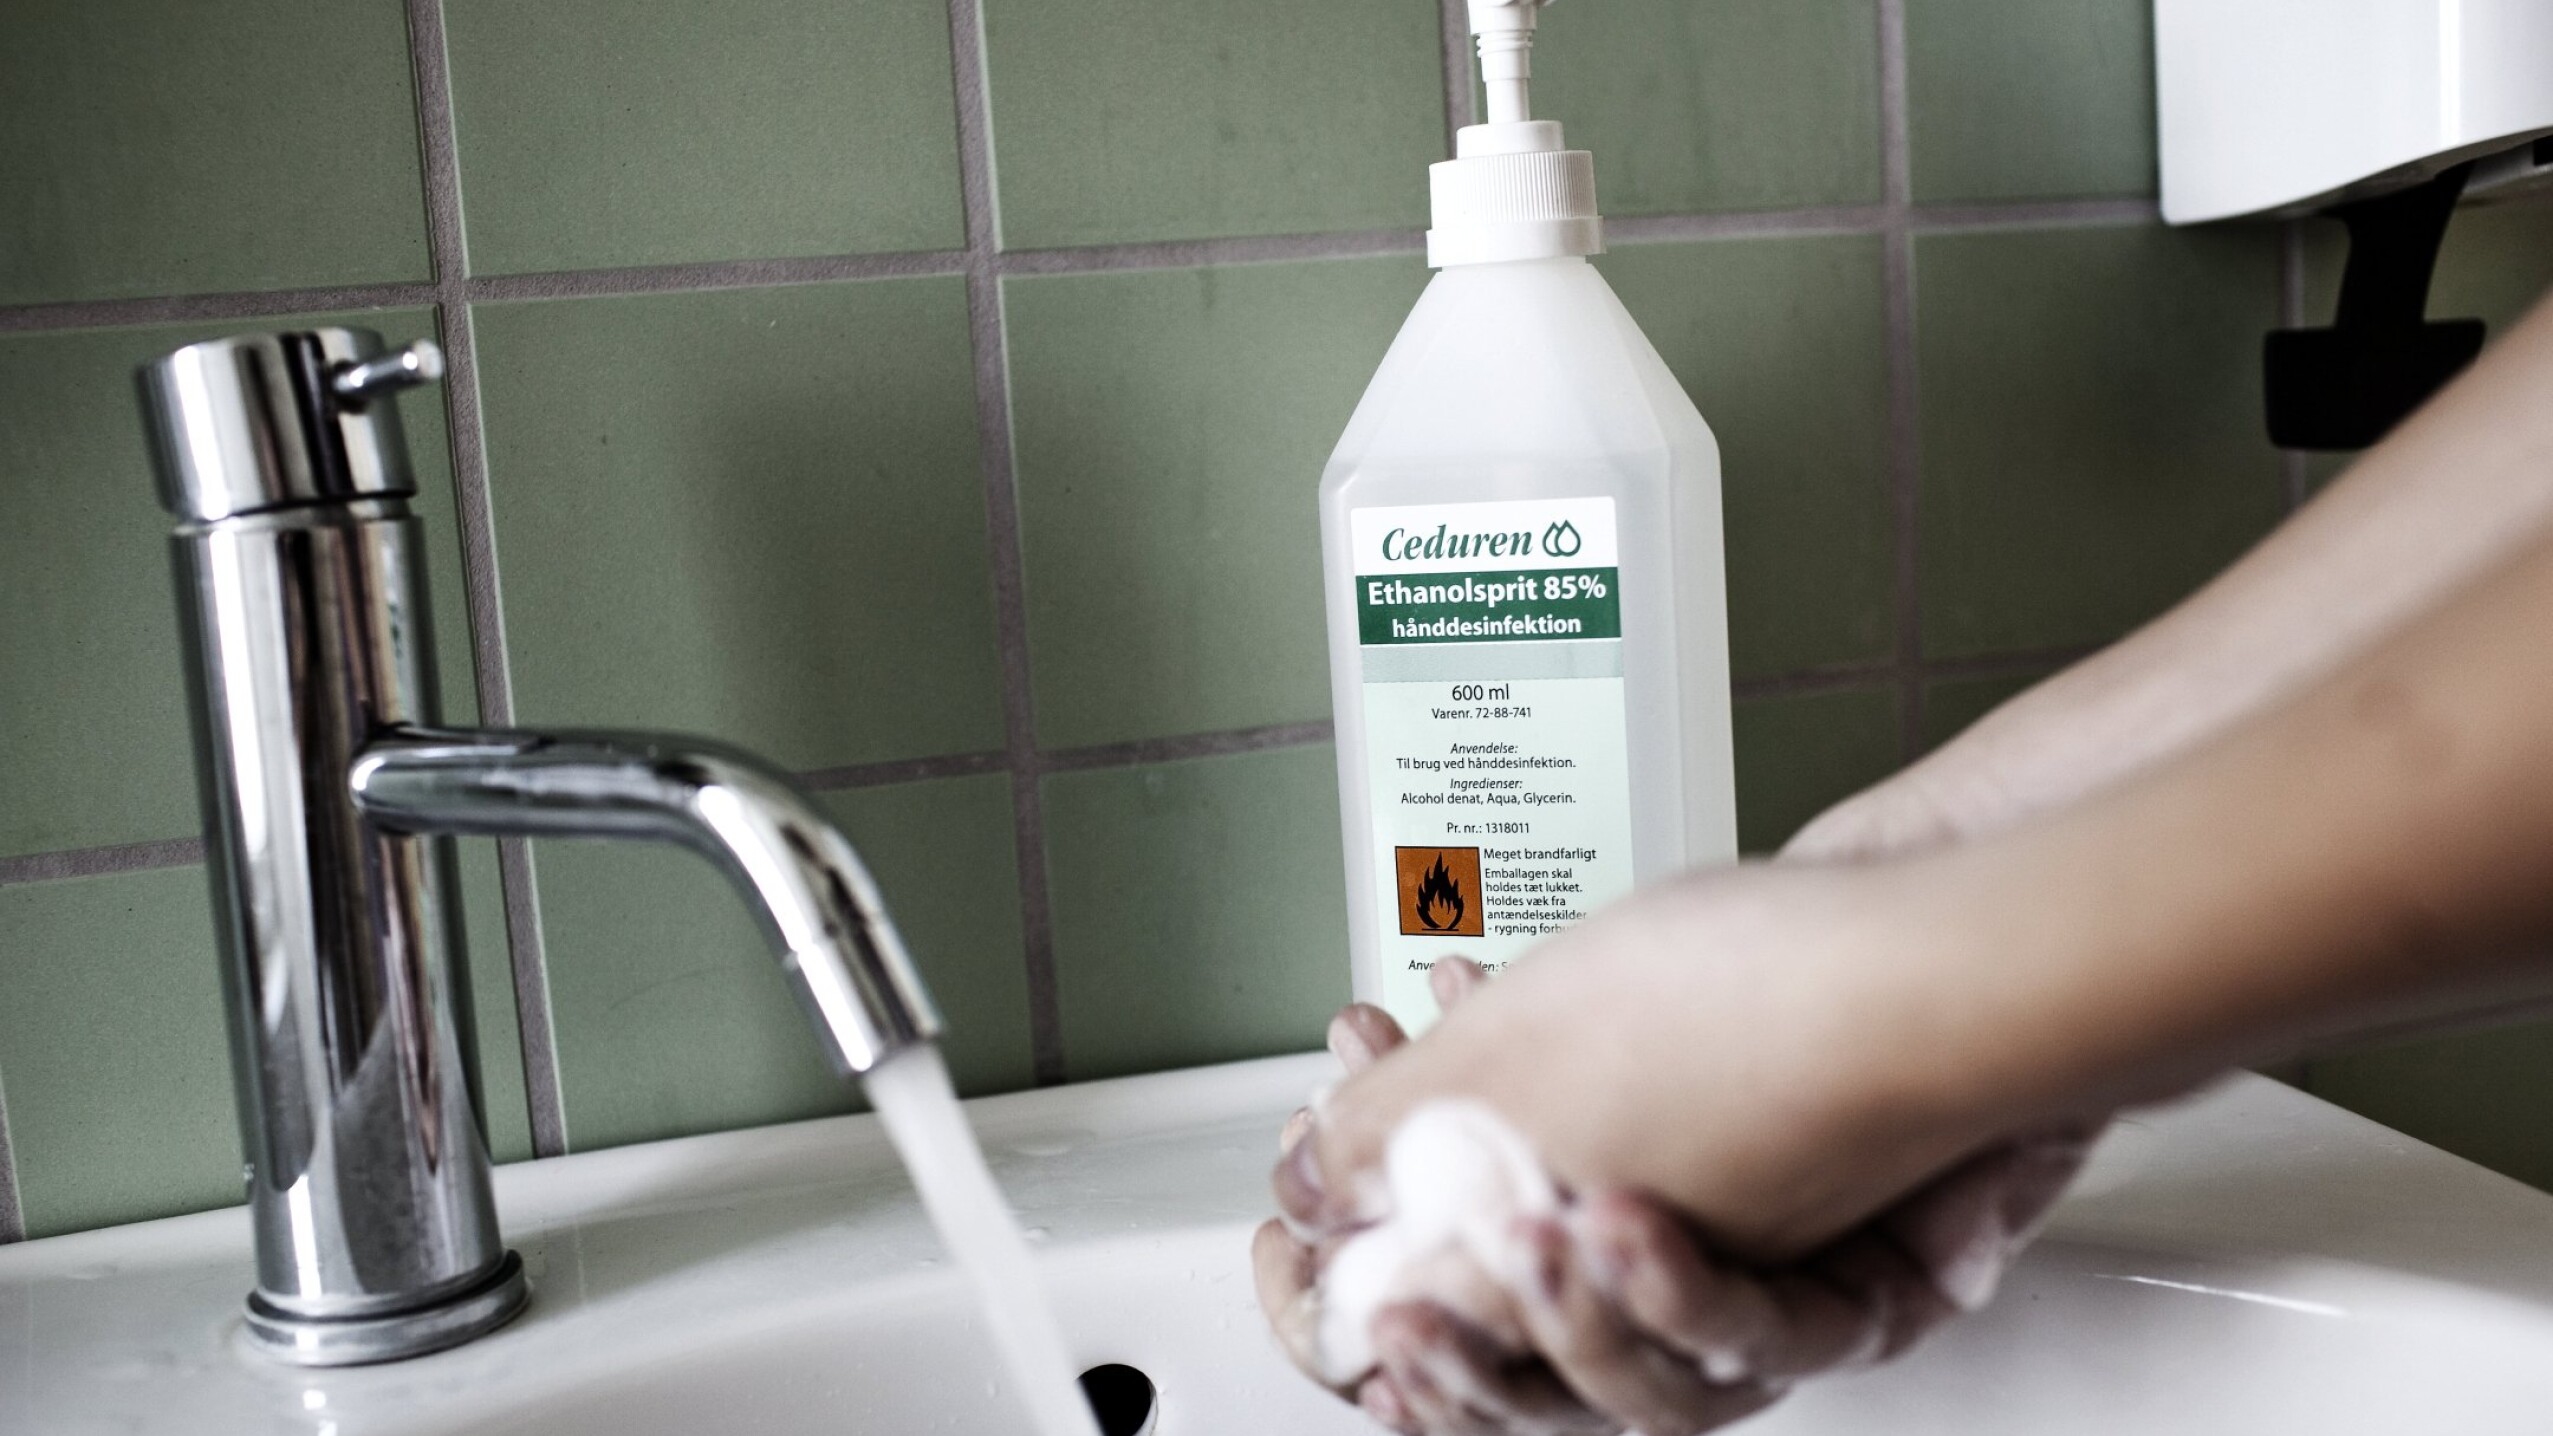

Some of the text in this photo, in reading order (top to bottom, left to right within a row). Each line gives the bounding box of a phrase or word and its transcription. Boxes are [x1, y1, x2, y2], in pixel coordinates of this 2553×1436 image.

[1382, 524, 1533, 561] Ceduren
[1368, 574, 1606, 608] Ethanolsprit 85%
[1392, 615, 1582, 638] hånddesinfektion
[1452, 683, 1509, 701] 600 ml
[1432, 707, 1531, 719] Varenr. 72-88-741
[1450, 742, 1518, 754] Anvendelse:
[1396, 757, 1576, 772] Til brug ved hånddesinfektion.
[1450, 779, 1522, 792] Ingredienser:
[1402, 793, 1576, 806] Alcohol denat, Aqua, Glycerin.
[1447, 822, 1529, 833] Pr. nr.: 1318011
[1484, 848, 1596, 862] Meget brandfarligt
[1485, 868, 1572, 881] Emballagen skal
[1486, 882, 1582, 892] holdes tæt lukket.
[1487, 896, 1565, 905] Holdes væk fra
[1495, 924, 1537, 936] rygning
